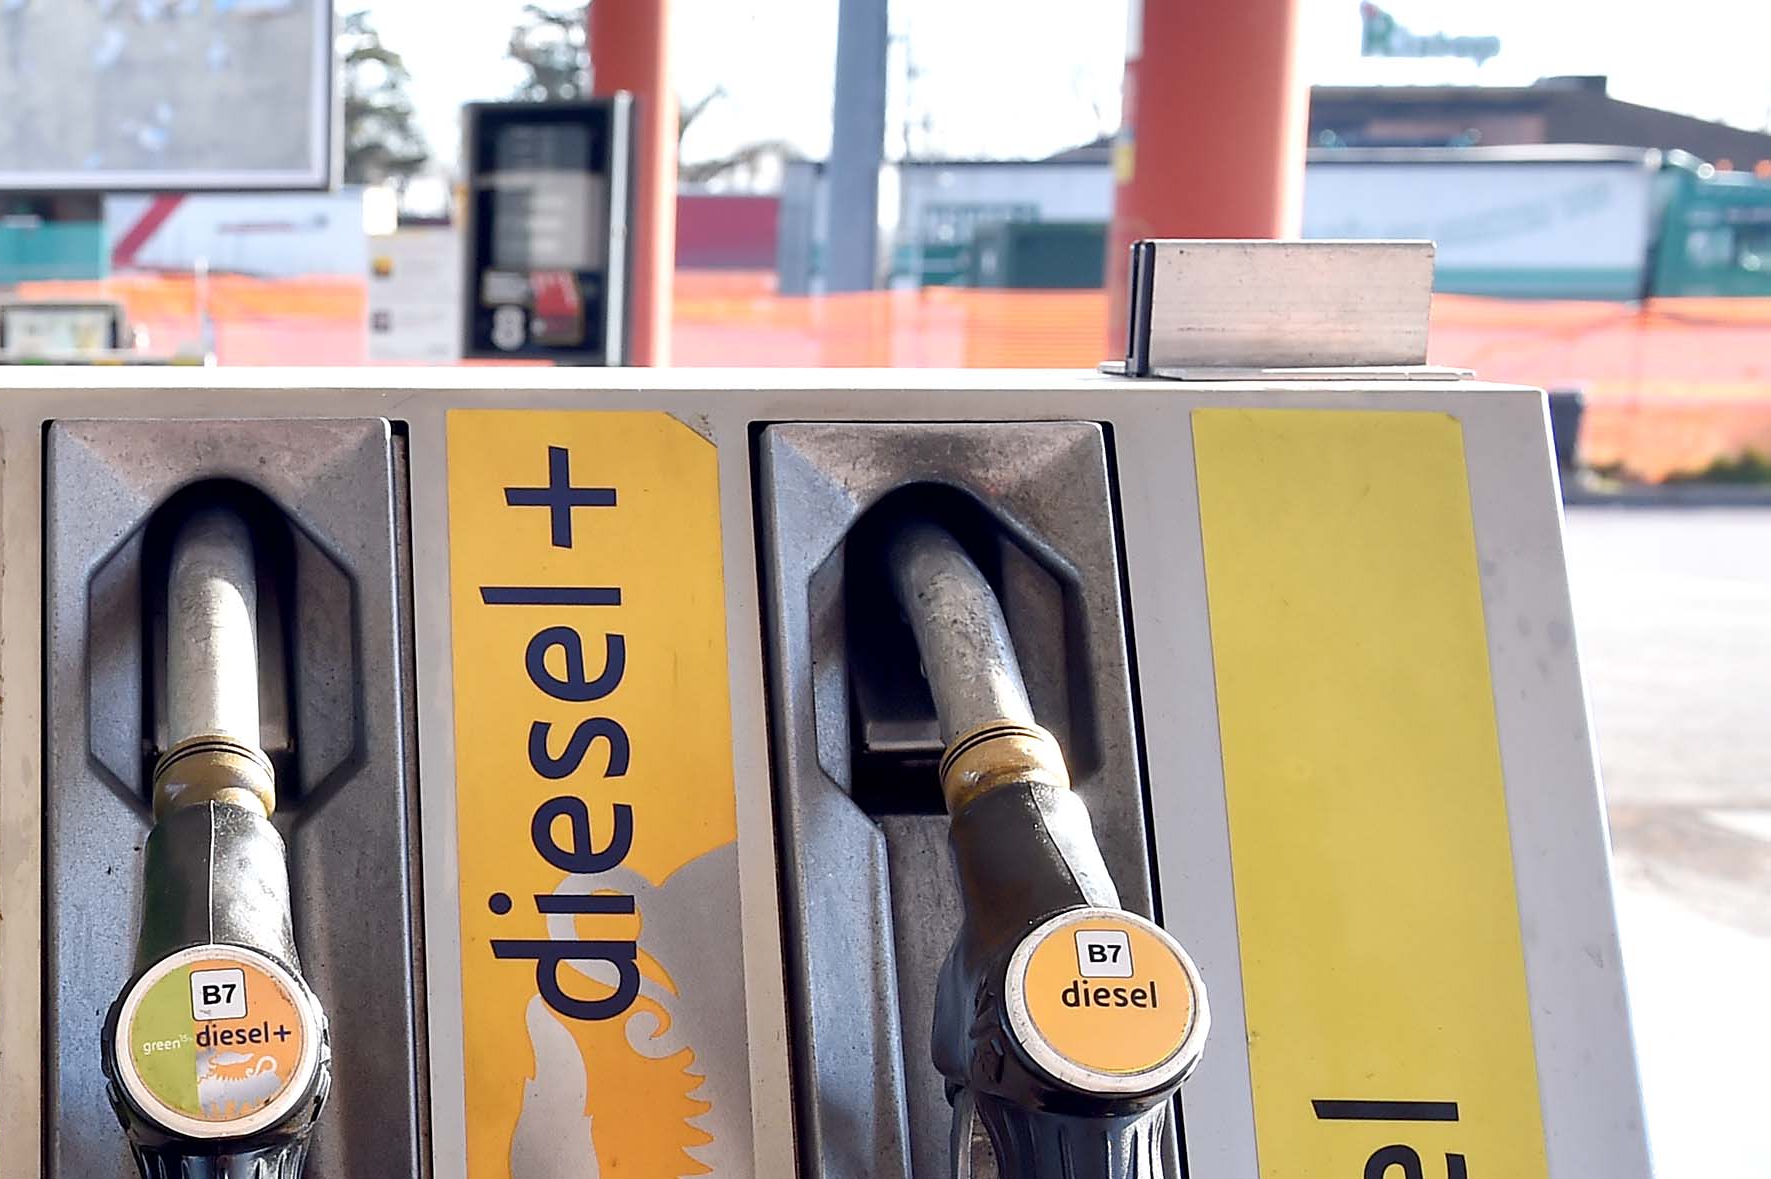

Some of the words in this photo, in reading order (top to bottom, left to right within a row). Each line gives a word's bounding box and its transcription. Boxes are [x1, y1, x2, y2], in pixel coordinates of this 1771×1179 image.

[479, 446, 641, 1021] diesel+
[1087, 944, 1122, 963] B7
[202, 983, 237, 1005] B7
[1061, 980, 1158, 1009] diesel
[143, 1039, 180, 1055] green
